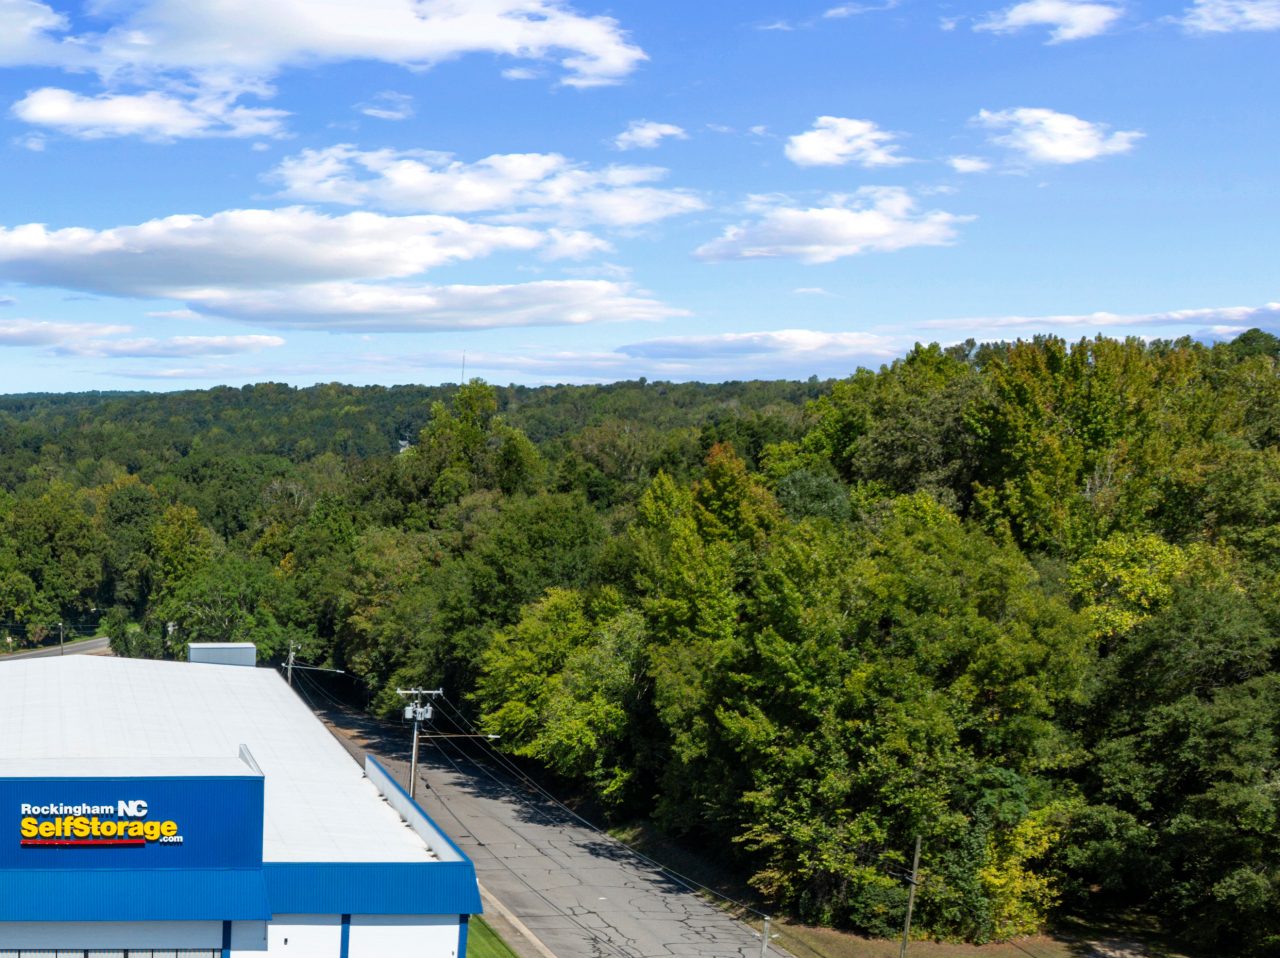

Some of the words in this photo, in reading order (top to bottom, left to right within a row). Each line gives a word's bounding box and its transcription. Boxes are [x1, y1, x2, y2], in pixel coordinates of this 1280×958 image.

[21, 803, 114, 816] Rockingham
[118, 800, 148, 817] NC
[21, 816, 178, 840] SelfStorage
[160, 835, 183, 843] .com
